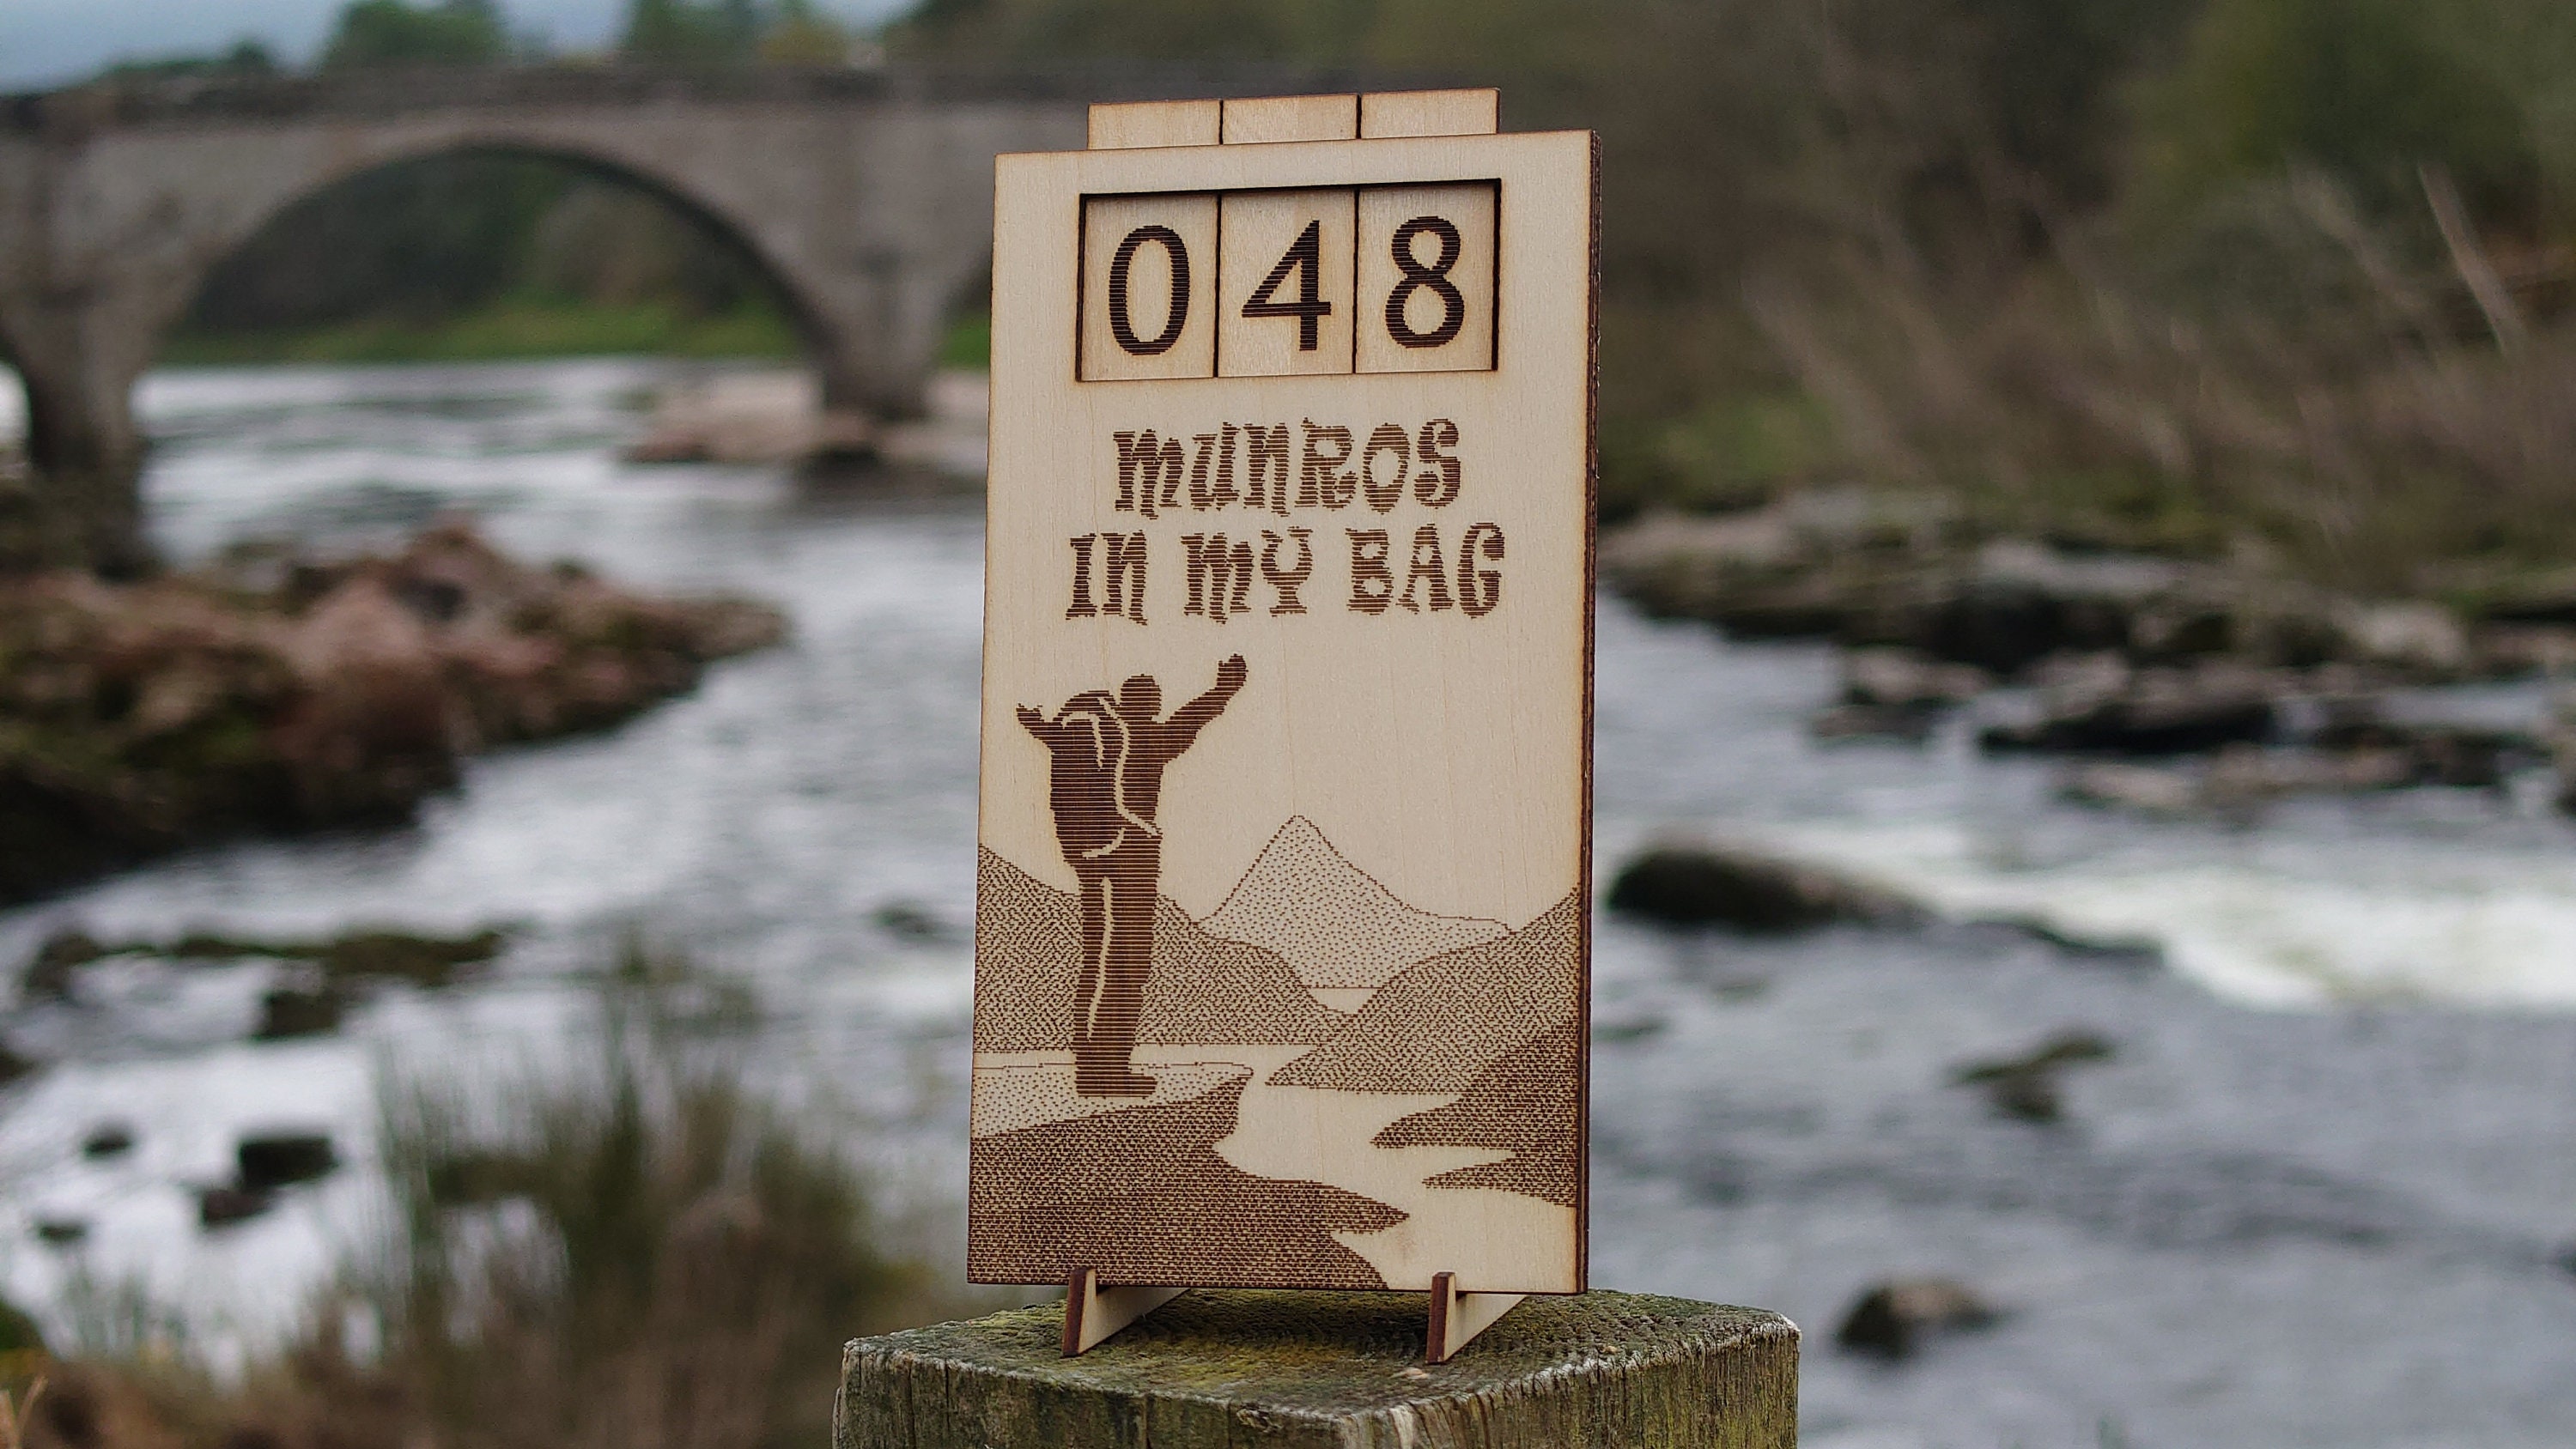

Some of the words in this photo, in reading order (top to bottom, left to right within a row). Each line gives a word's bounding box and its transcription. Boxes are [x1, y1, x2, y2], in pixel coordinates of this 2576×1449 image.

[1112, 416, 1461, 520] MUNROS
[1065, 529, 1149, 626] IN
[1180, 525, 1314, 624] MY
[1345, 521, 1505, 619] BAG
